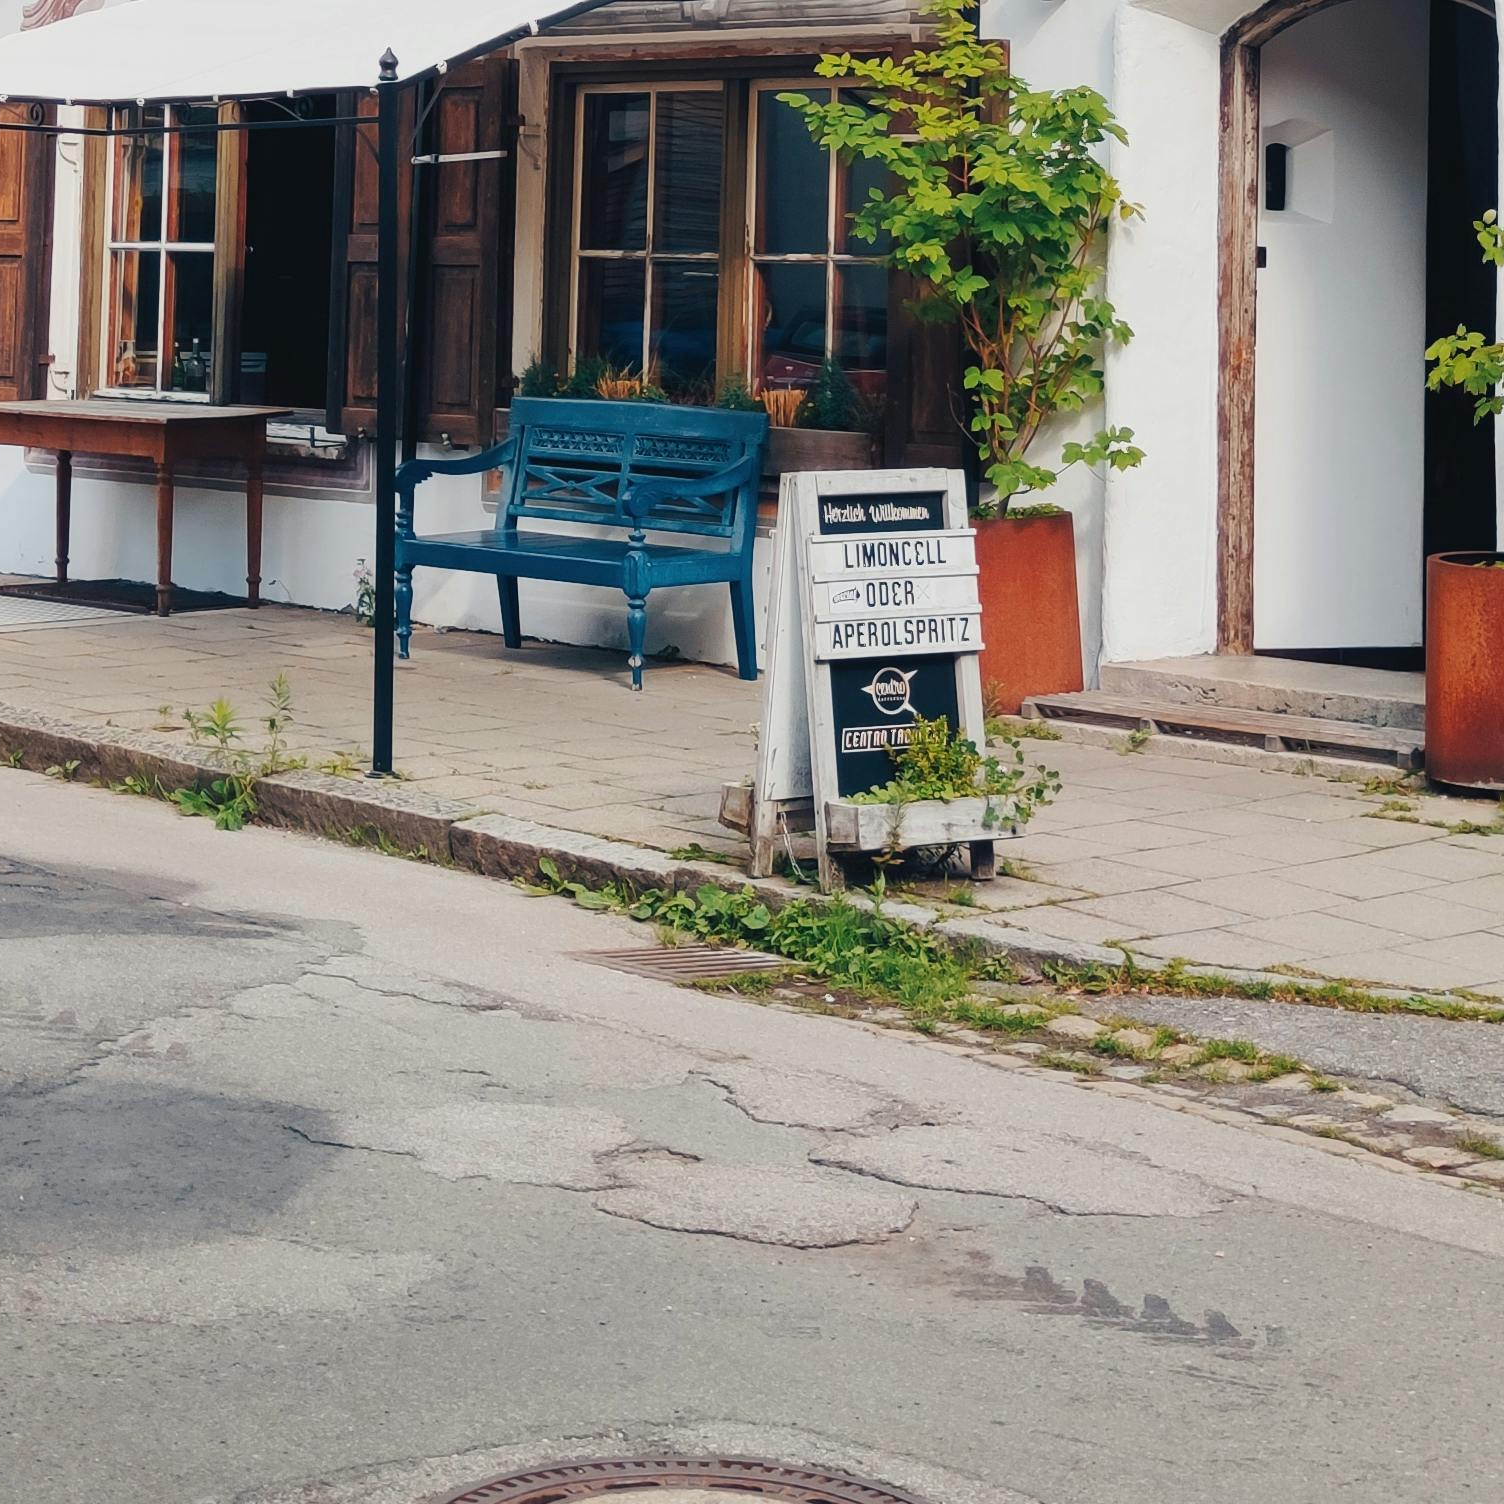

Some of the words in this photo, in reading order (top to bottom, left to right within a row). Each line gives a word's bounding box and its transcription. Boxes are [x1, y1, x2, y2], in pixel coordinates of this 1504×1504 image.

[824, 503, 866, 524] Herzlich
[869, 502, 930, 523] Willkommen
[844, 539, 947, 569] LIMONCELL
[866, 580, 915, 608] ODER
